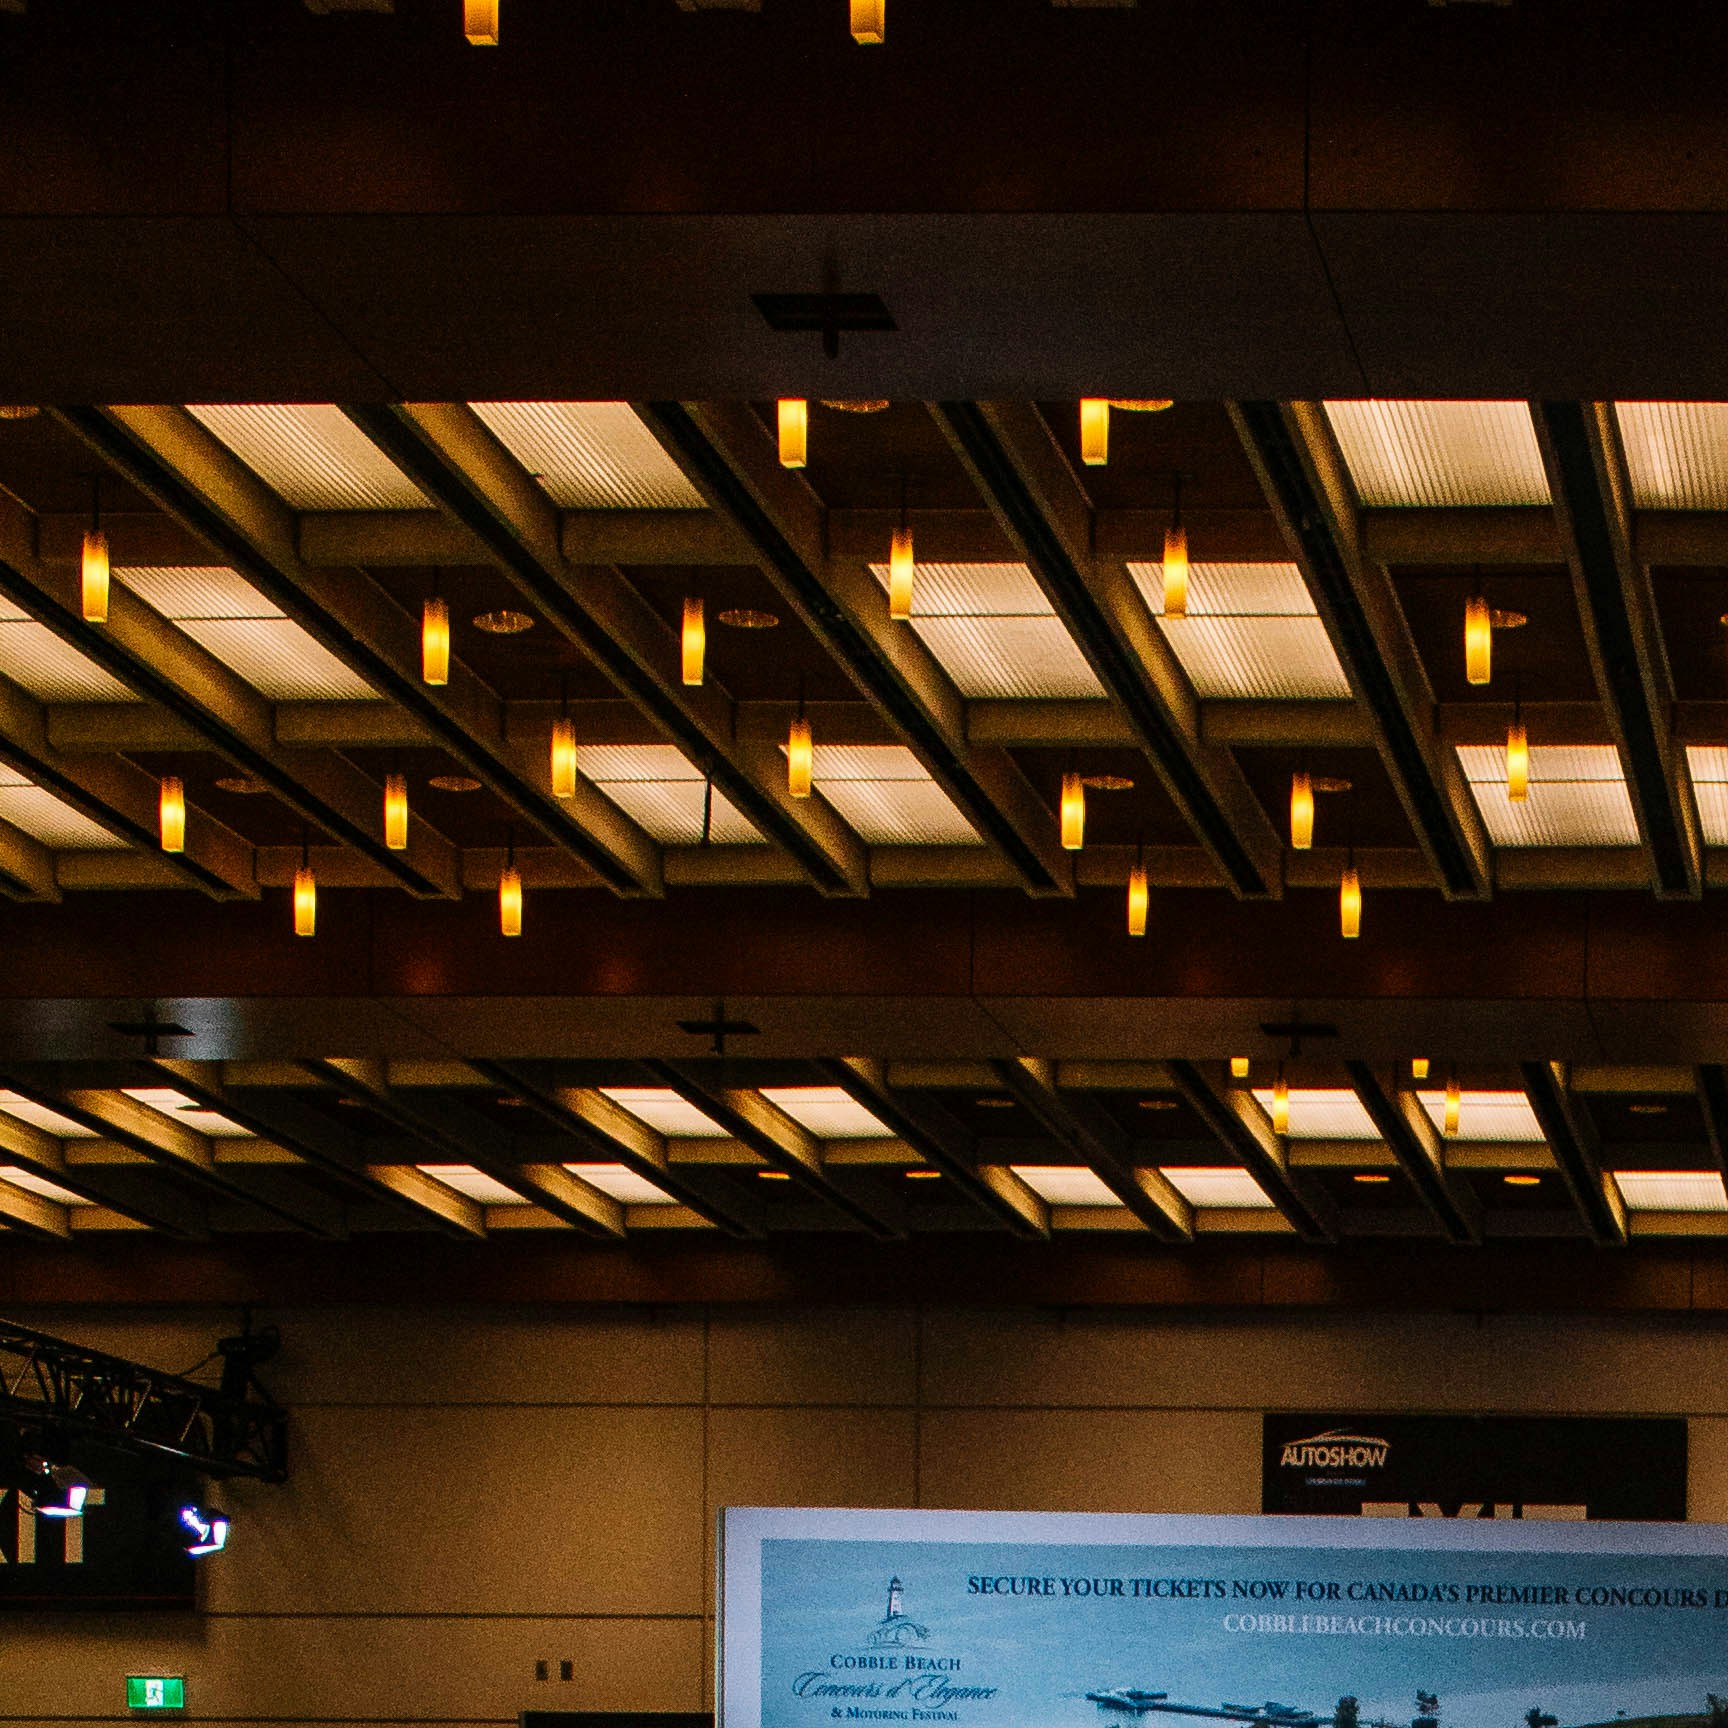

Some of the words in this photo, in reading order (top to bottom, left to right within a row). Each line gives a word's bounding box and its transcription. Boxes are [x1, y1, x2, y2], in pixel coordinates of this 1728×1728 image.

[1280, 1446, 1388, 1468] AUTOSHOW
[967, 1576, 1055, 1596] SECURE
[1061, 1577, 1126, 1597] YOUR
[1129, 1578, 1227, 1599] TICKETS
[1232, 1580, 1290, 1600] NOW
[1294, 1581, 1342, 1601] FOR
[1347, 1582, 1460, 1603] CANADA'S
[1466, 1584, 1568, 1604] PREMIER
[1575, 1587, 1708, 1608] CONCOURS
[1223, 1614, 1587, 1640] COBBLEBEACHCONCOURS.COM
[792, 1671, 884, 1699] Concours
[831, 1707, 842, 1718] &
